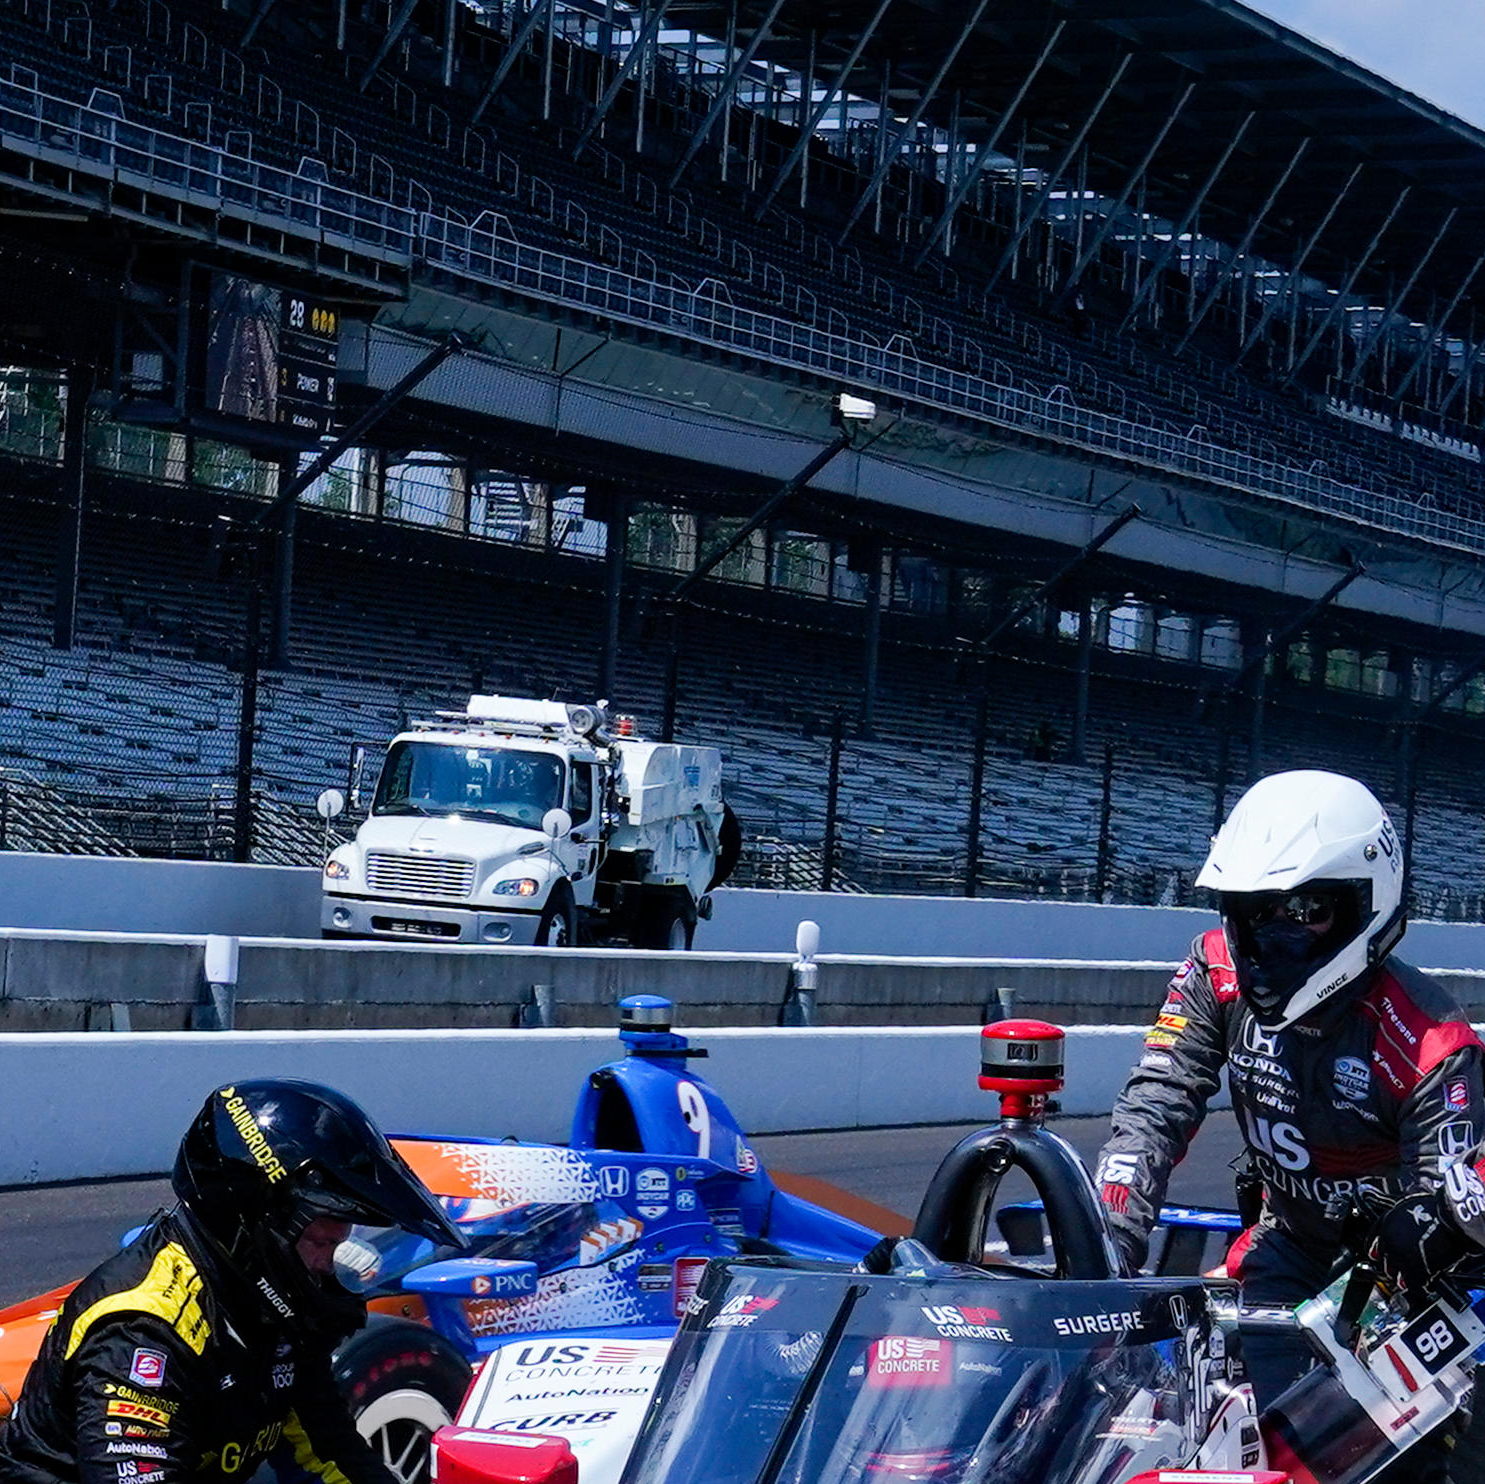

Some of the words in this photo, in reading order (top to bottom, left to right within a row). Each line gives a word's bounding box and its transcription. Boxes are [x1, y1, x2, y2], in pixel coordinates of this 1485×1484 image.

[1316, 973, 1349, 1000] VINCE
[1227, 1050, 1293, 1082] HONDA
[676, 1079, 711, 1159] 9
[225, 1096, 287, 1184] GAINBRIDGE
[1245, 1105, 1310, 1171] US
[495, 1273, 532, 1293] PNC
[256, 1276, 295, 1320] THUGGY
[721, 1294, 754, 1315] US
[707, 1313, 759, 1329] CONCRETE
[921, 1305, 963, 1325] US
[1053, 1311, 1146, 1336] SURGERE
[937, 1324, 1014, 1343] CONCRETE
[1414, 1319, 1456, 1363] 98
[516, 1345, 590, 1367] US
[877, 1339, 905, 1360] US
[877, 1359, 940, 1374] CONCRETE
[116, 1385, 181, 1414] GAINBRIDGE
[505, 1387, 649, 1404] AutoNation
[116, 1402, 166, 1423] DHL
[489, 1410, 618, 1431] CURB
[117, 1461, 137, 1477] US
